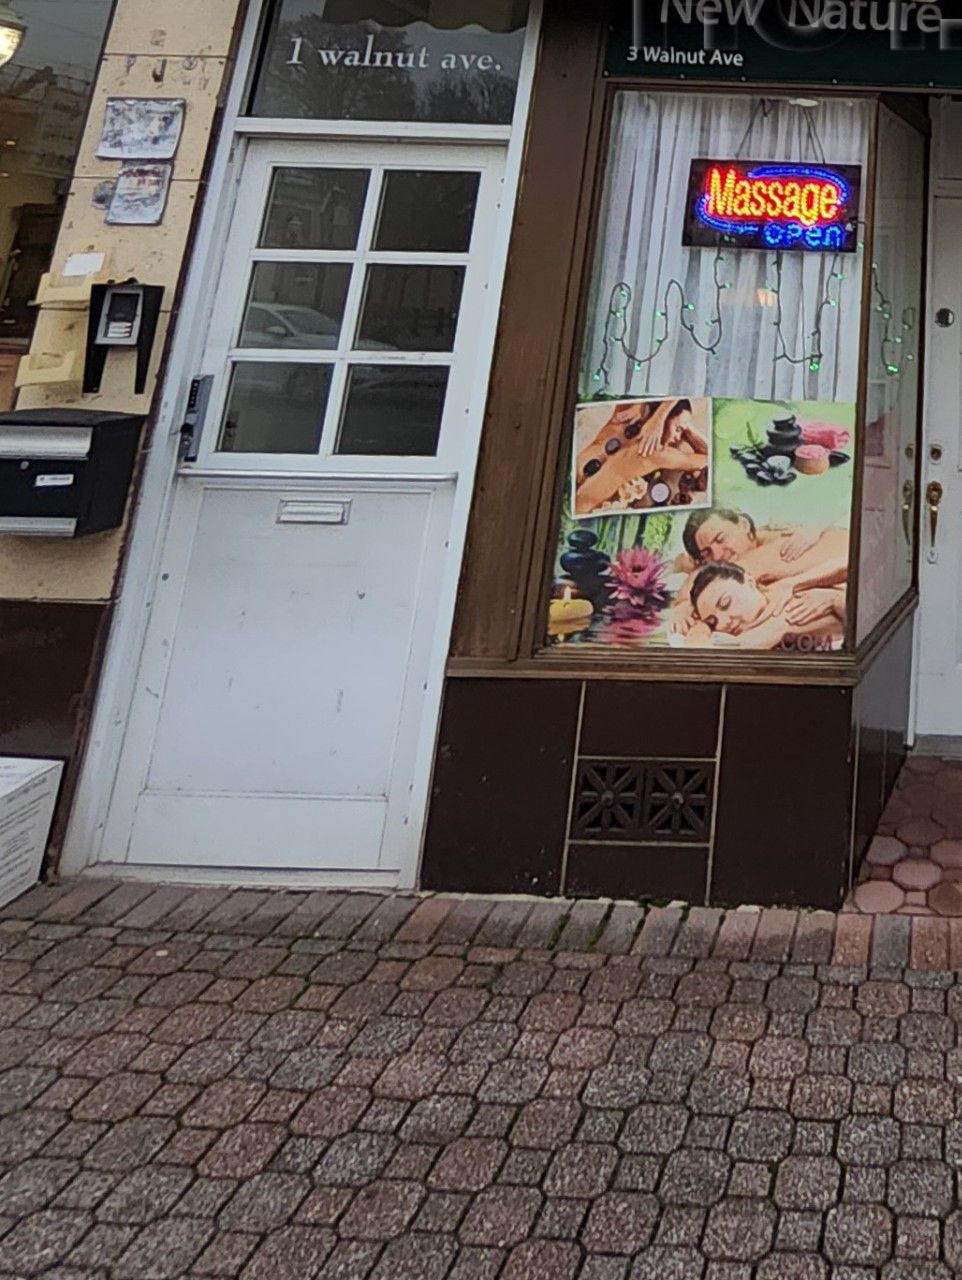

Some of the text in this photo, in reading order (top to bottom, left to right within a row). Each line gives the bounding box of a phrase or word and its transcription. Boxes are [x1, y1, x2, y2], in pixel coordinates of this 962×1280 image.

[286, 35, 501, 72] 1 walnut ave.
[627, 46, 744, 67] 3 Walnut Ave
[707, 167, 839, 226] Massage
